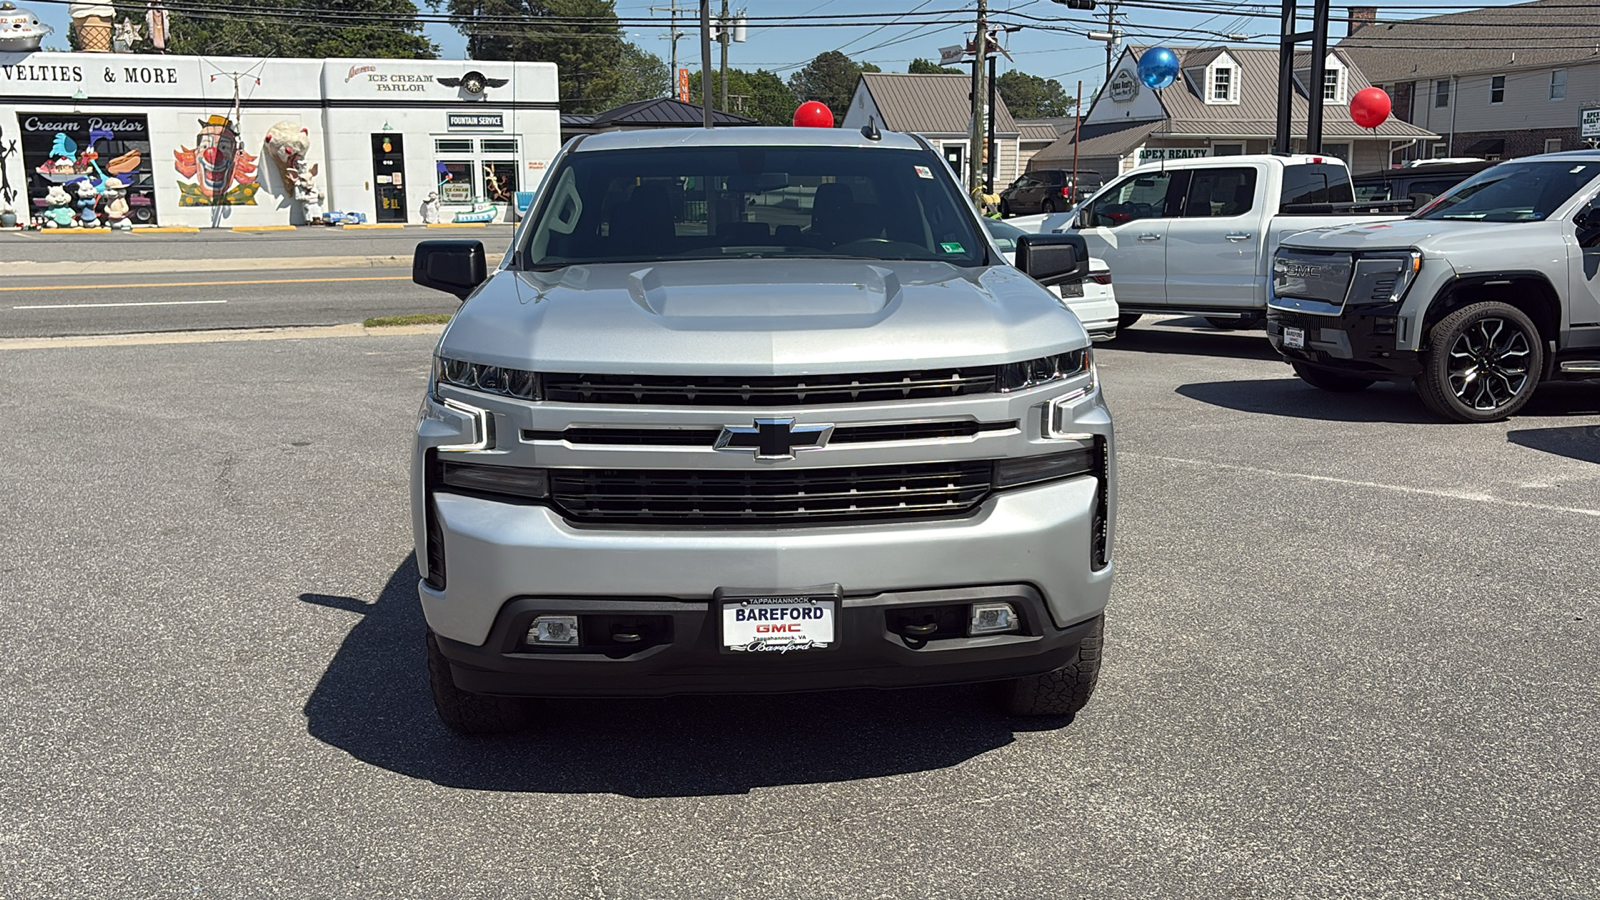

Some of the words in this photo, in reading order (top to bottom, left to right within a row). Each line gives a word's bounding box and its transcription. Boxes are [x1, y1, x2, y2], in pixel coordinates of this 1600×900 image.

[2, 64, 83, 82] VELTIES
[104, 67, 116, 83] &
[124, 67, 178, 83] MORE
[368, 74, 388, 82] ICE
[390, 74, 434, 82] CREAM
[377, 83, 425, 92] PARLOR
[24, 116, 81, 132] Cream
[87, 117, 144, 133] Parlor
[450, 116, 478, 125] FOUNTAIN
[478, 116, 502, 125] SERVICE
[1139, 149, 1165, 159] APEX
[1169, 149, 1208, 159] REALTY
[1286, 264, 1321, 278] GMC
[748, 597, 809, 605] TAPPAHANNOCK
[735, 607, 824, 622] BAREFORD
[756, 623, 801, 633] GMC
[747, 640, 812, 654] Bareford
